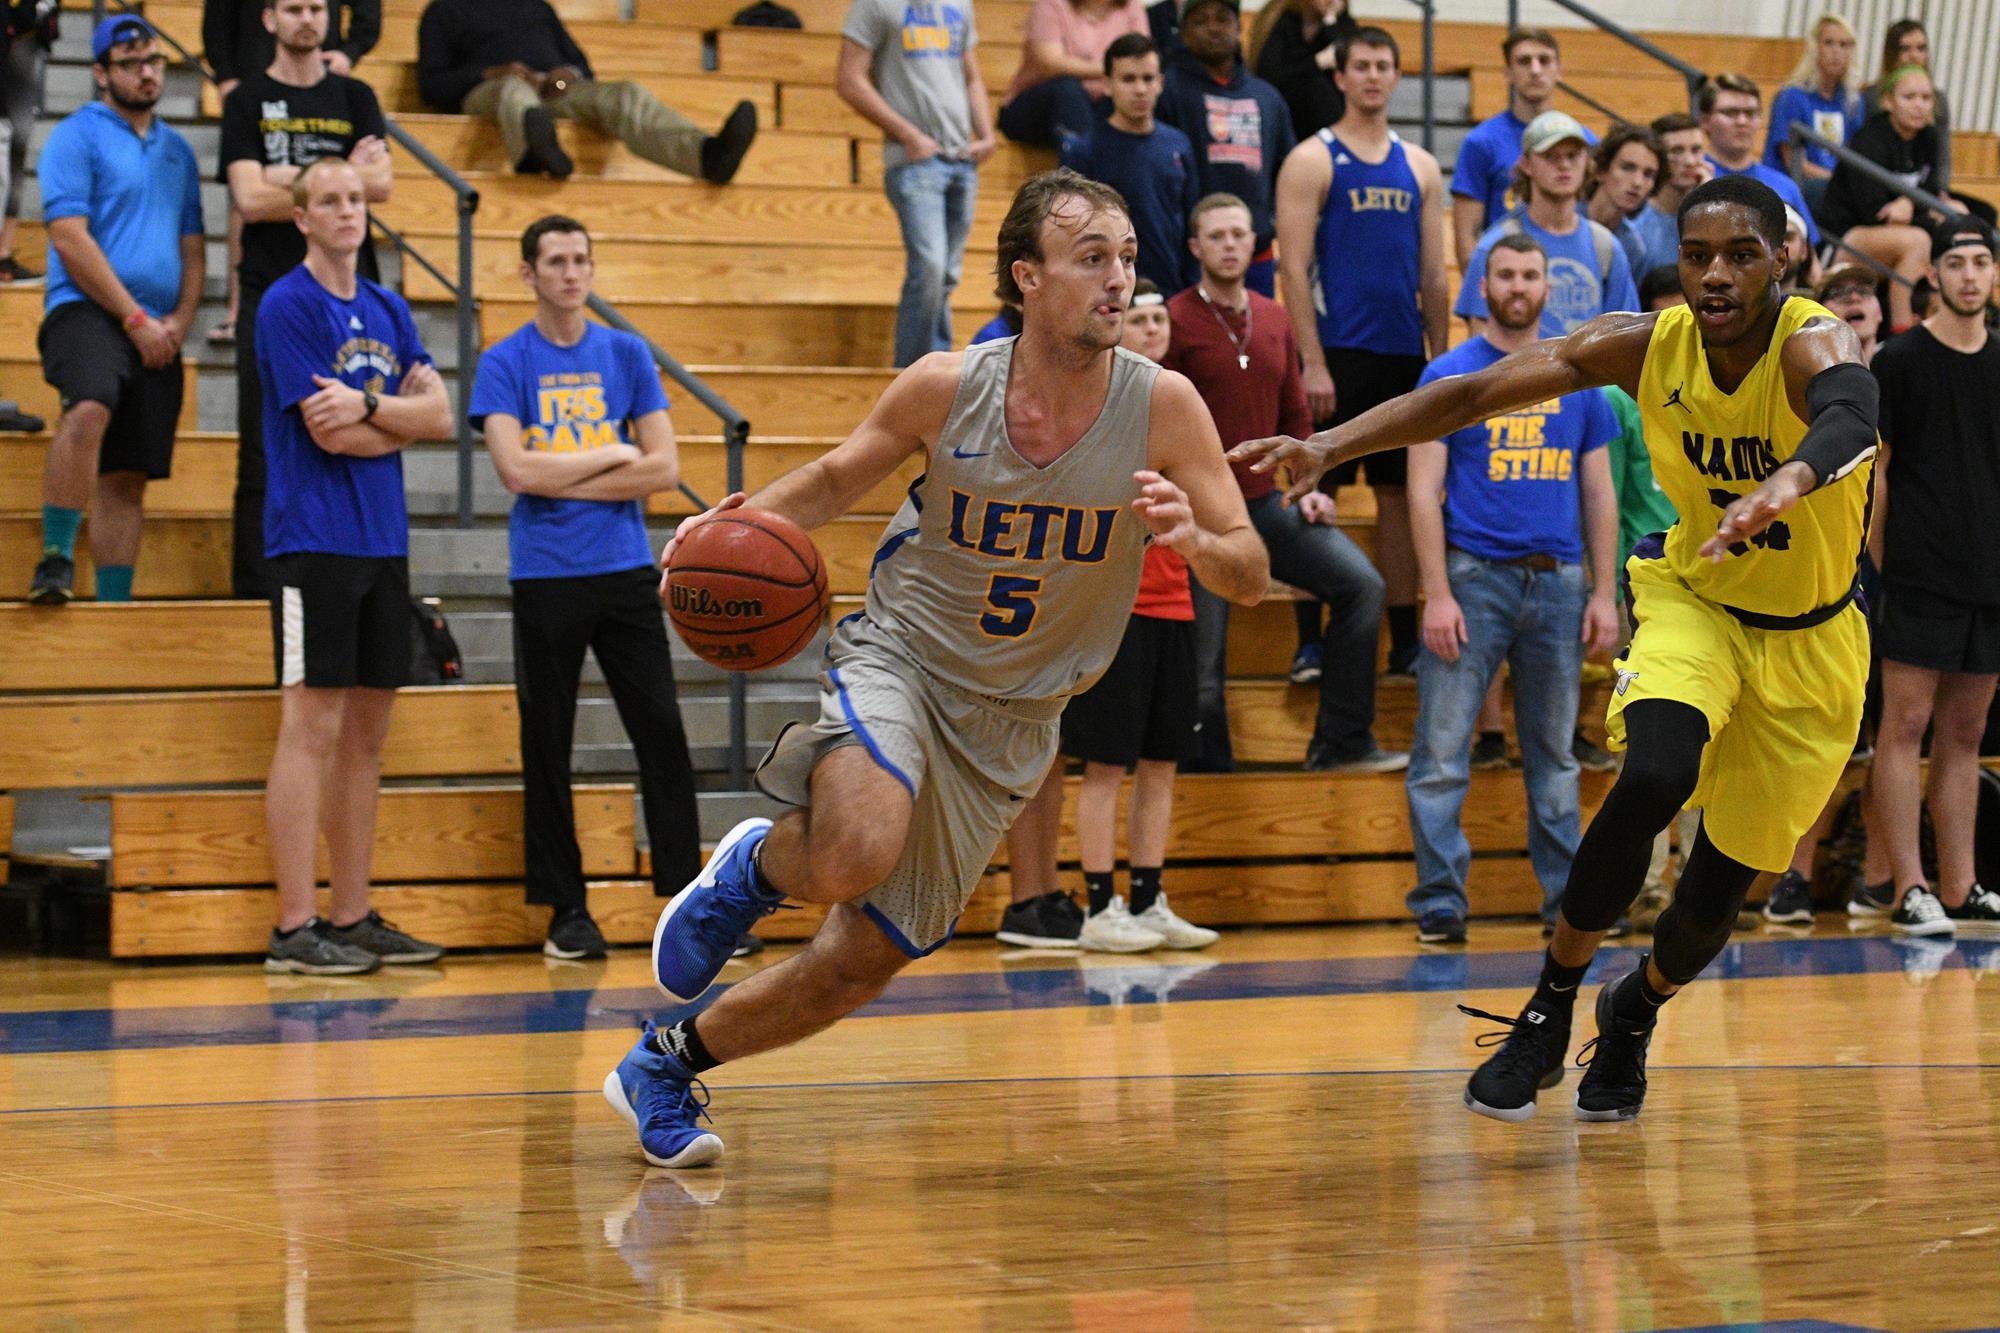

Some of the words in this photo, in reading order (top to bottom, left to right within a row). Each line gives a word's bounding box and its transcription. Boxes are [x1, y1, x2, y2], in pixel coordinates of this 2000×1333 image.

[1348, 187, 1413, 212] LETU
[521, 420, 621, 454] GAM
[1485, 415, 1546, 448] THE
[1487, 448, 1573, 482] STING
[947, 486, 1122, 566] LETU
[670, 584, 763, 617] Wilson
[978, 571, 1044, 641] 5
